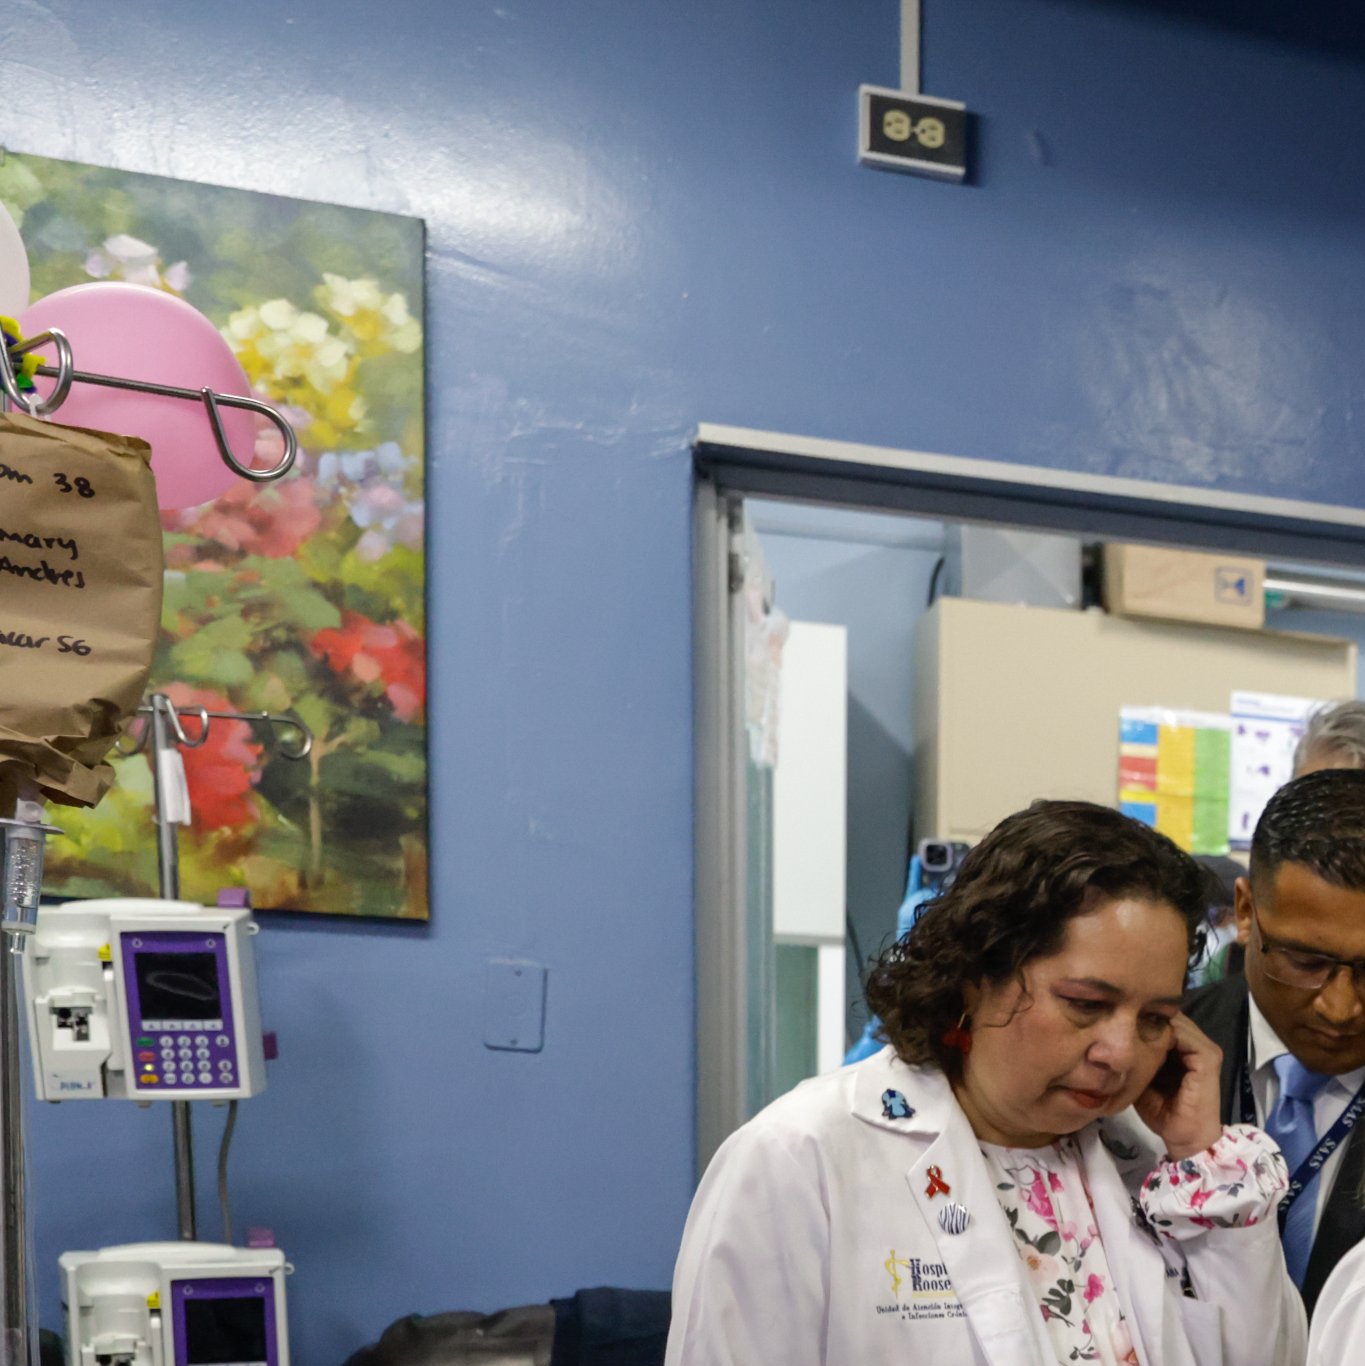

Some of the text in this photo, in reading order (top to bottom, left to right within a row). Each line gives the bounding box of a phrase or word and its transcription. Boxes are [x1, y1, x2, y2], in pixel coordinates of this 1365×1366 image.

[53, 472, 96, 499] 38
[1309, 1138, 1337, 1170] SAAS
[911, 1274, 952, 1292] Roose
